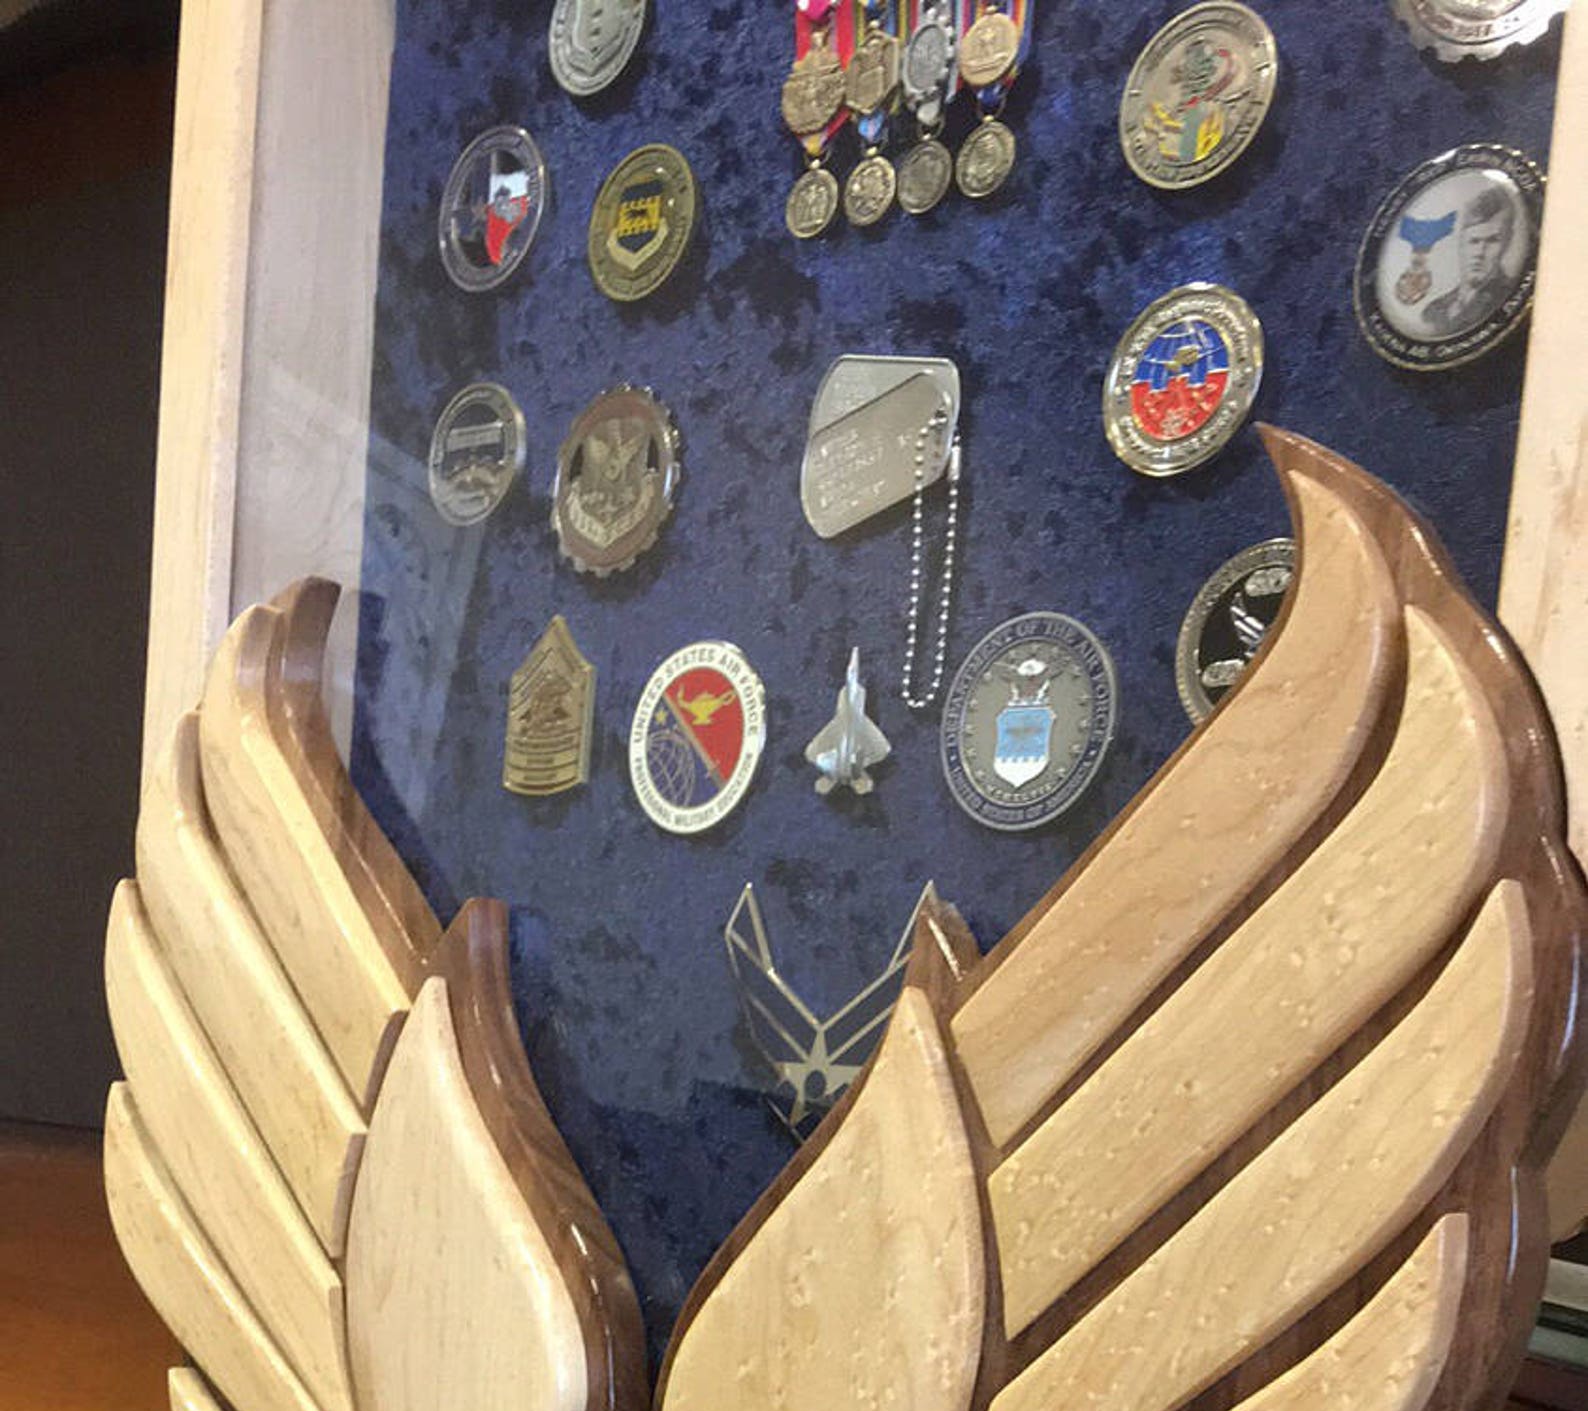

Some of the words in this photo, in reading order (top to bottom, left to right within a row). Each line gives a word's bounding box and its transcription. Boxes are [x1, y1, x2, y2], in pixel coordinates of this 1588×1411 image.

[633, 677, 664, 743] UNITED
[666, 648, 715, 678] STATES
[718, 652, 742, 677] AIR
[739, 676, 759, 735] FORCE
[945, 629, 1013, 747] DEPARTMENT
[1015, 621, 1039, 637] OF
[1045, 621, 1076, 643] THE
[1073, 641, 1101, 671] AIR
[1091, 666, 1110, 742] FORCE
